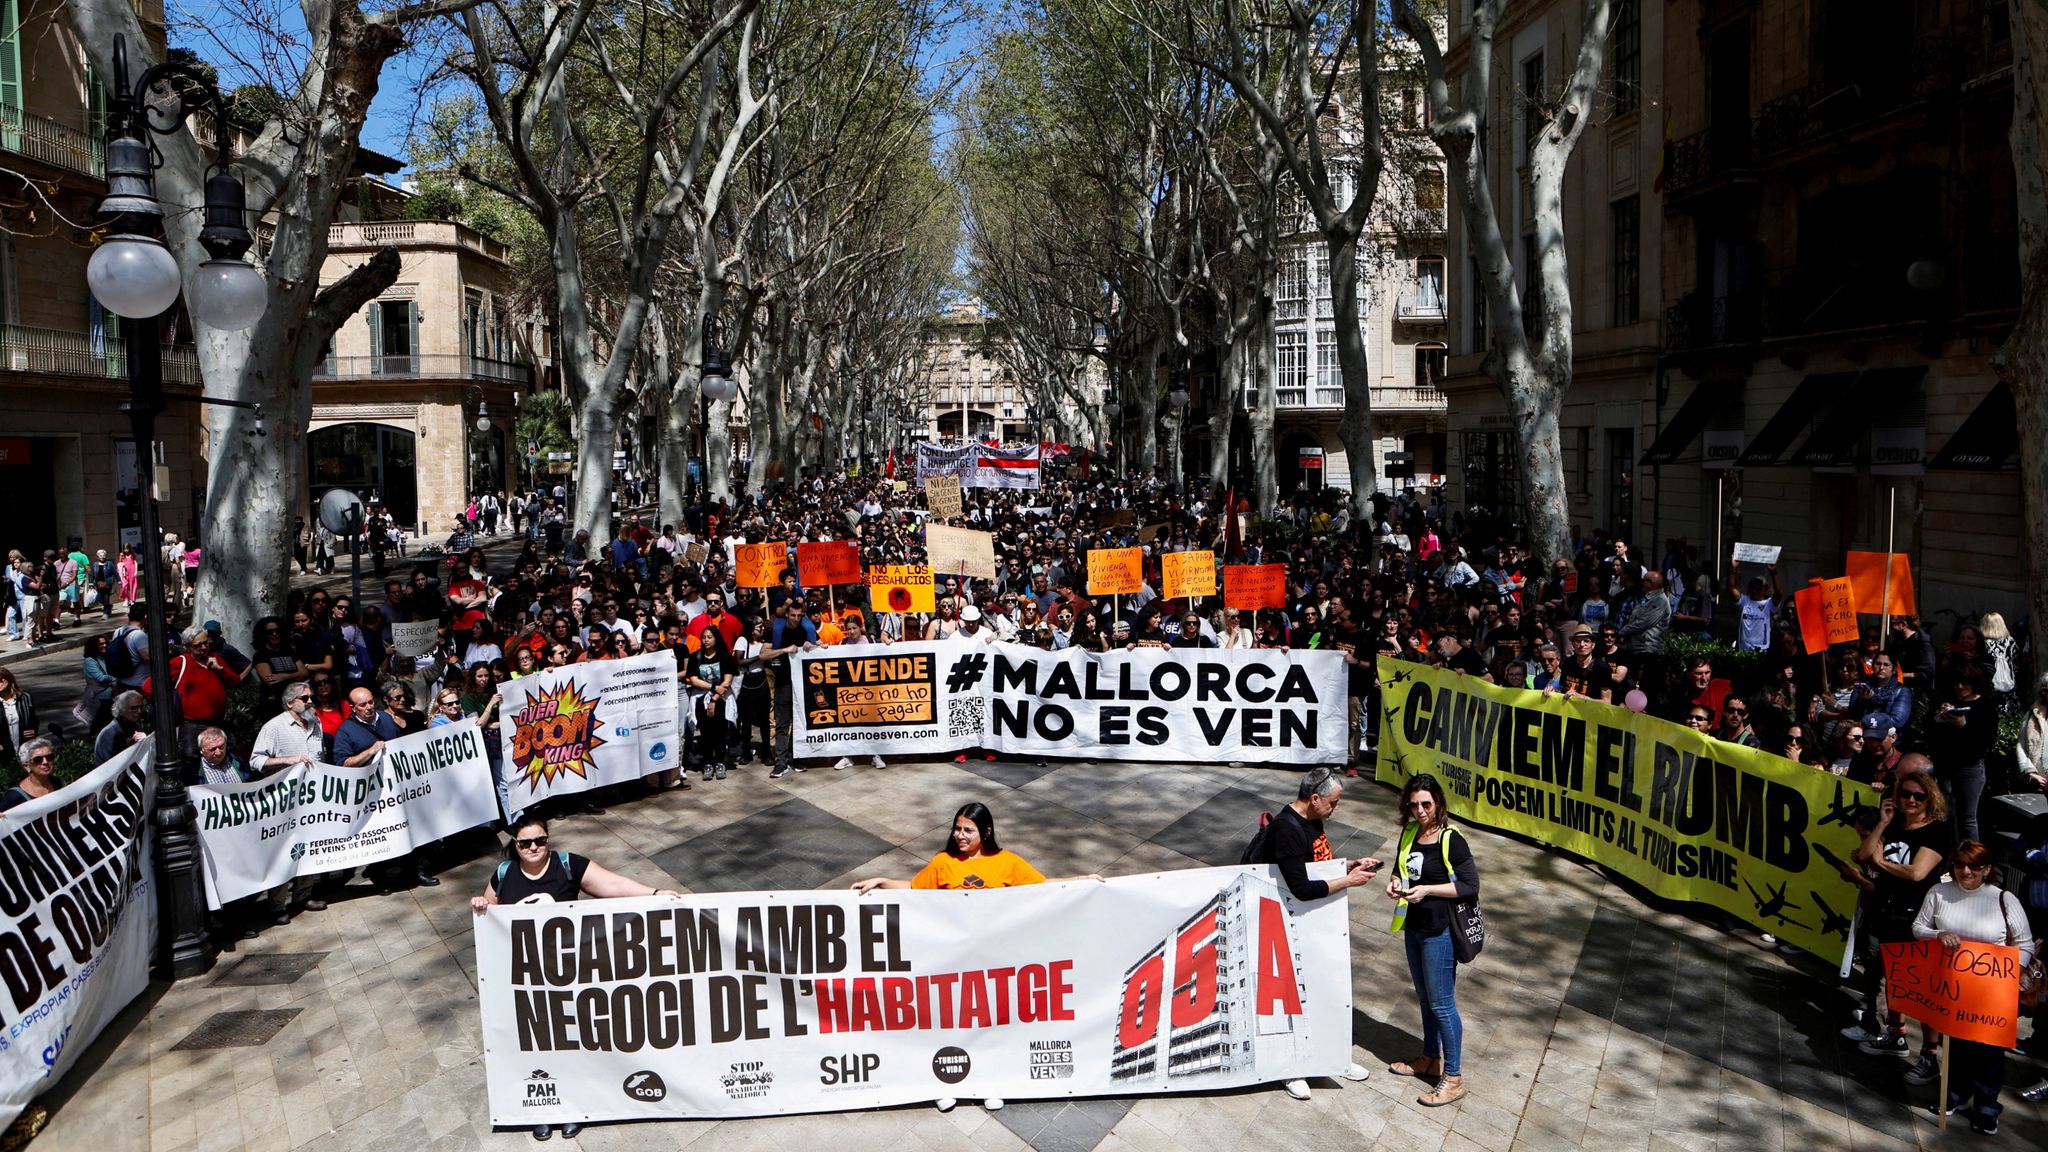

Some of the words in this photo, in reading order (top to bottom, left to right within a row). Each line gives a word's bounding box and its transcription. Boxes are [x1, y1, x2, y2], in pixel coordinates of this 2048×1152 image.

[920, 447, 955, 457] CONTRA
[961, 448, 970, 456] LA
[931, 480, 939, 488] NI
[930, 489, 939, 497] SIN
[940, 488, 958, 496] GENTE
[940, 496, 959, 504] GENTE
[931, 506, 941, 514] SIN
[736, 545, 786, 564] CONTROL
[1106, 551, 1112, 560] A
[1117, 550, 1134, 559] UNA
[752, 569, 771, 583] YA
[803, 564, 829, 574] DIGNA
[874, 566, 887, 575] NO
[895, 566, 901, 574] A
[913, 565, 928, 575] LOS
[1091, 564, 1127, 576] VIVIENDA
[871, 575, 932, 585] DESAHUCIOS
[1096, 580, 1119, 588] TODOS
[1171, 576, 1214, 588] ESPECULAR
[1828, 583, 1847, 592] UNA
[1838, 599, 1849, 607] ES
[808, 661, 840, 684] SE
[846, 656, 929, 683] VENDE
[945, 652, 1319, 704] #MALLORCA
[838, 687, 874, 704] Però
[879, 688, 899, 701] no
[906, 685, 928, 700] ho
[518, 700, 560, 726] OVER
[877, 703, 923, 722] pagar
[992, 698, 1075, 742] NO
[1099, 705, 1170, 746] ES
[1192, 707, 1319, 749] VEN
[512, 708, 592, 761] BOOM
[806, 728, 939, 744] mallorcanoesven.com
[544, 743, 584, 766] KING
[299, 776, 317, 807] és
[321, 774, 350, 805] UN
[389, 751, 411, 783] NO
[410, 752, 429, 777] un
[427, 730, 479, 772] NEGOCI
[1403, 681, 1587, 793] CANVIEM
[1594, 723, 1642, 814] EL
[1648, 741, 1810, 874] RUMB
[260, 817, 297, 841] barris
[299, 808, 351, 826] contra
[1474, 773, 1545, 819] POSEM
[1549, 790, 1616, 844] LÍMITS
[1617, 816, 1637, 856] AL
[1641, 823, 1739, 892] TURISME
[309, 848, 320, 856] DE
[361, 835, 387, 847] PALMA
[511, 907, 723, 987] ACABEM
[735, 903, 847, 975] AMB
[859, 903, 912, 972] EL
[1883, 942, 1929, 959] UN
[1939, 949, 2016, 979] HOGAR
[1890, 961, 1921, 983] ES
[1929, 975, 1960, 1001] UN
[11, 987, 71, 1039] EXPROPIAR
[71, 962, 95, 992] CASES
[514, 978, 697, 1053] NEGOCI
[708, 975, 770, 1044] DE
[780, 959, 1075, 1037] L'HABITATGE
[1890, 984, 1950, 1016] DERECHO
[1955, 1009, 2007, 1028] HUMANO
[1029, 1040, 1072, 1050] MALLORCA
[1032, 1053, 1050, 1063] NO
[1053, 1052, 1071, 1062] ES
[730, 1061, 764, 1073] STOP
[820, 1053, 880, 1085] SHP
[1030, 1067, 1056, 1079] VEN
[527, 1083, 557, 1098] PAH
[635, 1087, 663, 1097] GOB
[725, 1084, 771, 1095] DESAHUCIOS
[730, 1091, 768, 1100] MALLORCA
[522, 1097, 561, 1107] MALLORCA
